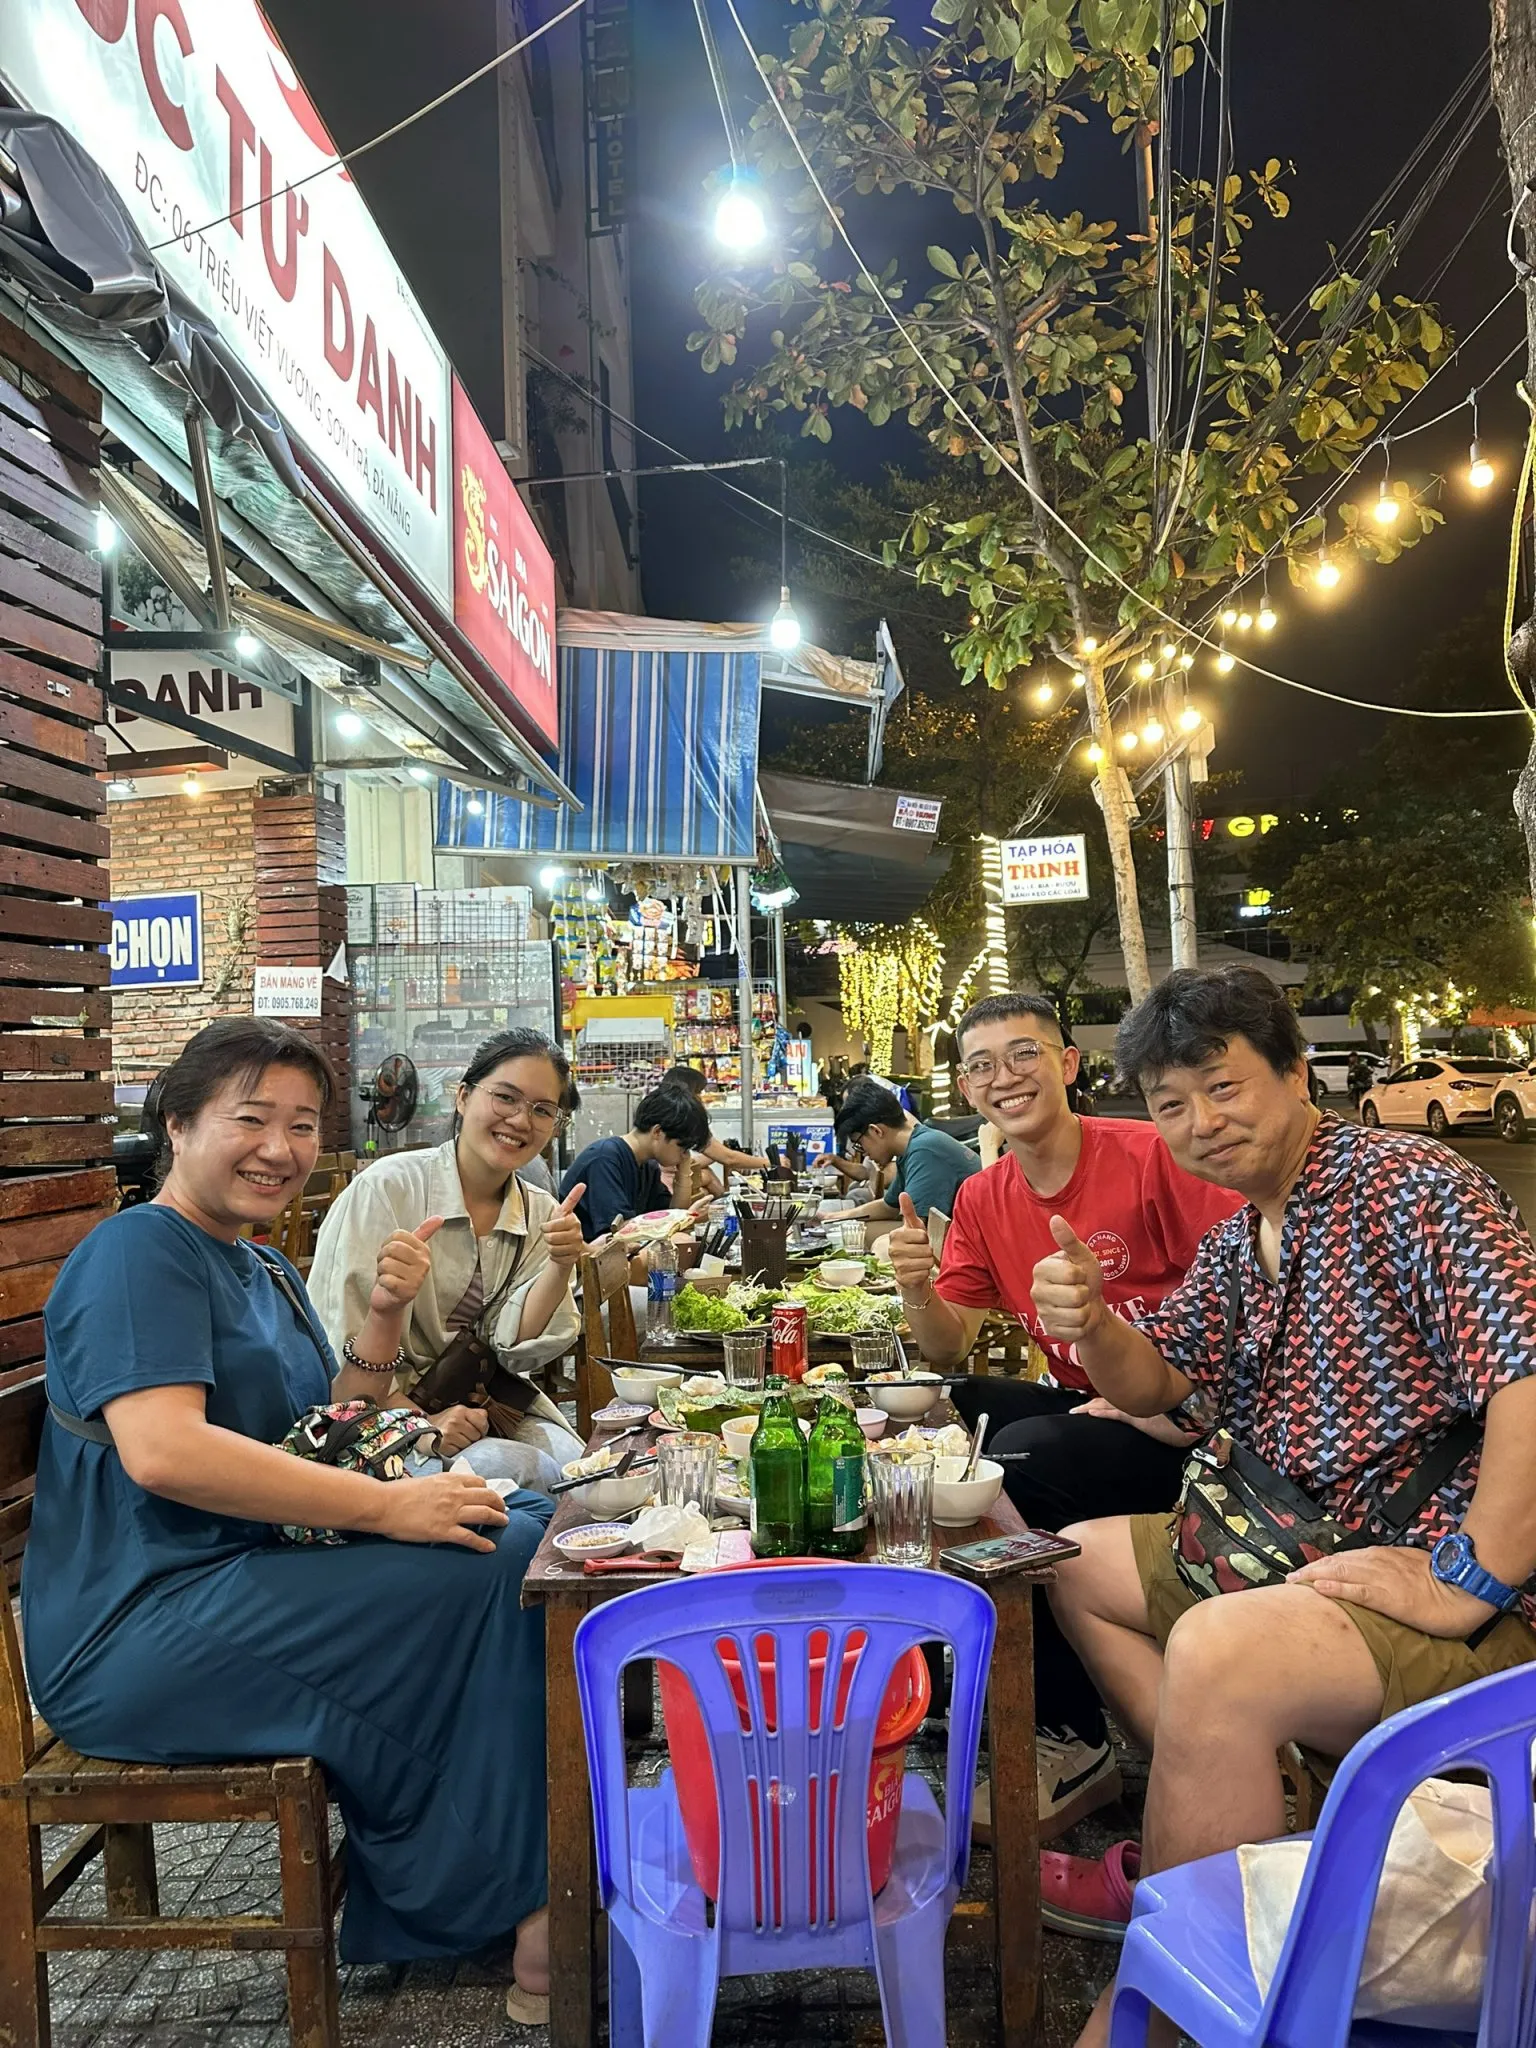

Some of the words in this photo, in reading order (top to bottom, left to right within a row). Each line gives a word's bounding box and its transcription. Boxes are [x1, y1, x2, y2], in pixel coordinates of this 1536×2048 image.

[606, 121, 625, 217] MOTEL
[135, 151, 168, 223] ĐC:
[172, 204, 192, 253] 06
[197, 232, 241, 315] TRIỆU
[245, 295, 274, 358] VIỆT
[215, 63, 309, 302] TƯ
[323, 241, 437, 516] DANH
[487, 538, 551, 688] SAIGON
[1008, 845, 1037, 861] TẠP
[1042, 839, 1077, 856] HÓA
[1007, 860, 1080, 880] TRINH
[108, 916, 193, 978] CHỌN
[260, 973, 278, 989] BÁN
[280, 976, 305, 989] MANG
[271, 996, 319, 1010] 0905.768.249
[1102, 1246, 1121, 1257] SINCE
[1100, 1258, 1115, 1268] 2013
